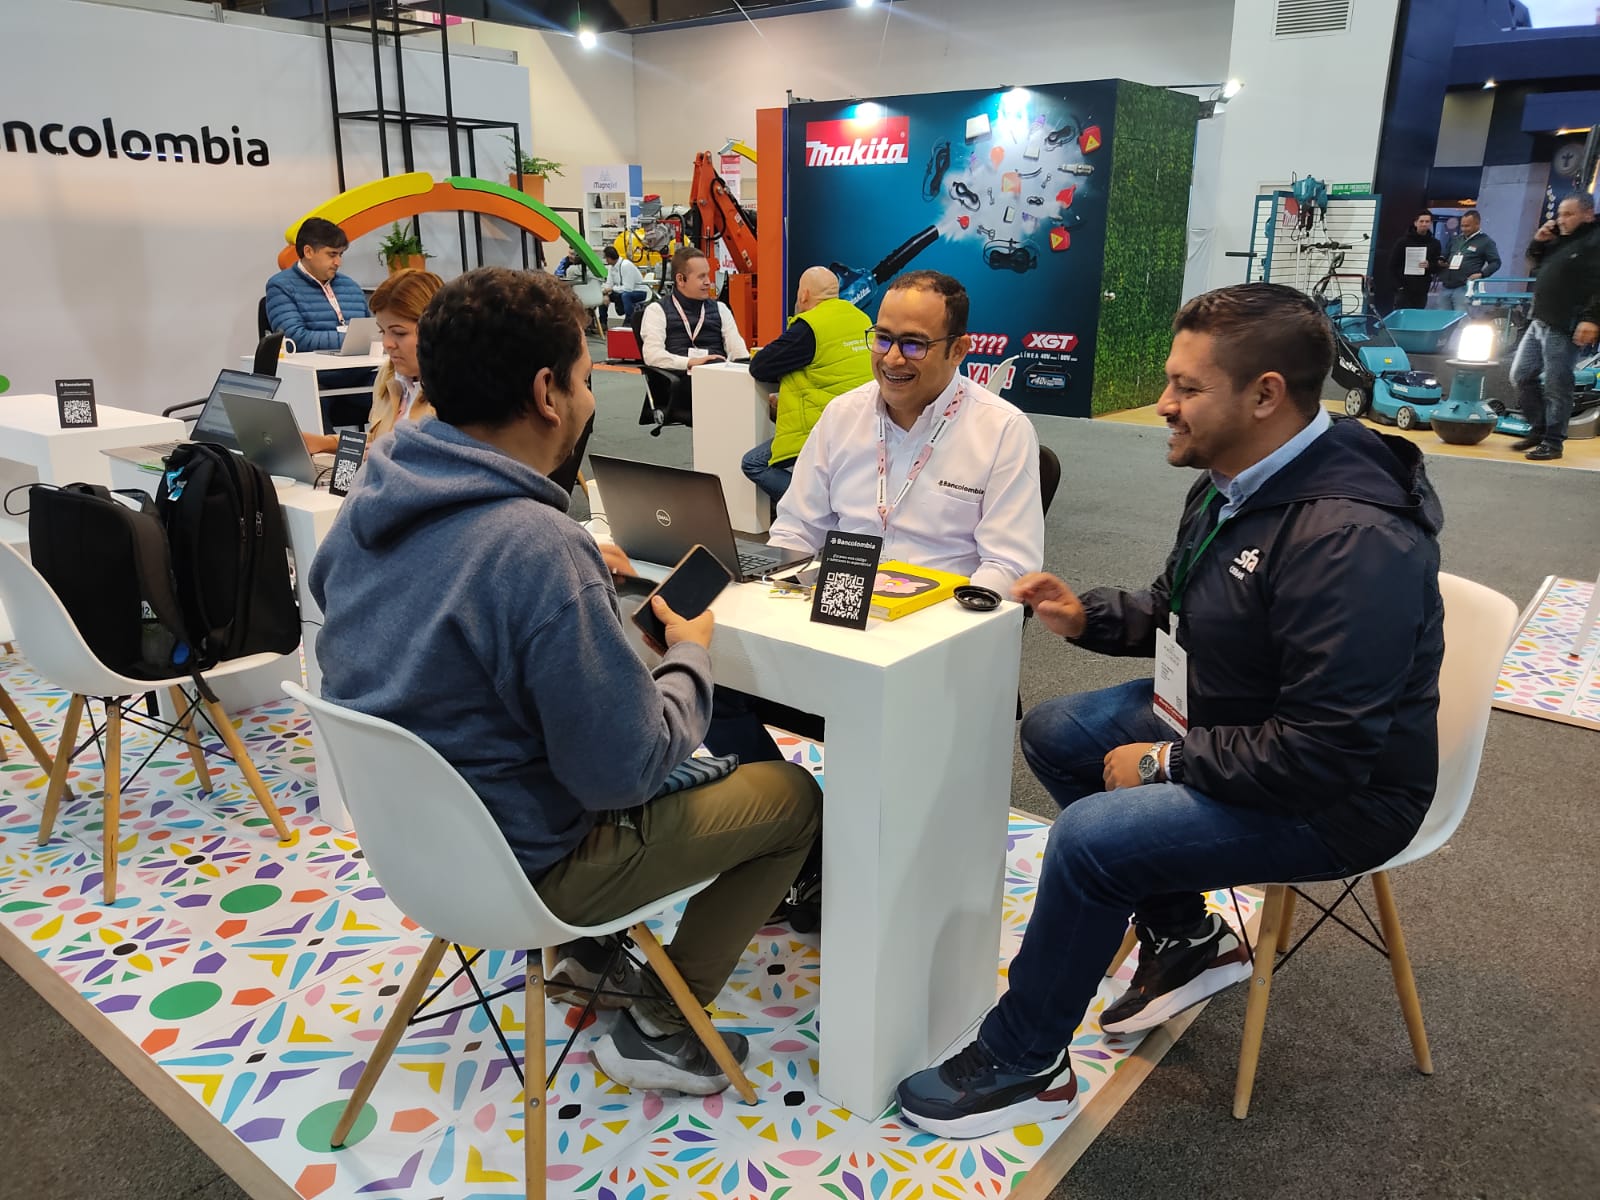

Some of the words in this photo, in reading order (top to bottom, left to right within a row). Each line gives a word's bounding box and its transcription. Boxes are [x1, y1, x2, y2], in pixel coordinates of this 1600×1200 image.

[0, 117, 269, 167] ncolombia
[806, 137, 908, 167] makita
[1028, 333, 1073, 349] XGT
[943, 480, 985, 495] Bancolombia
[837, 538, 876, 549] Bancolombia
